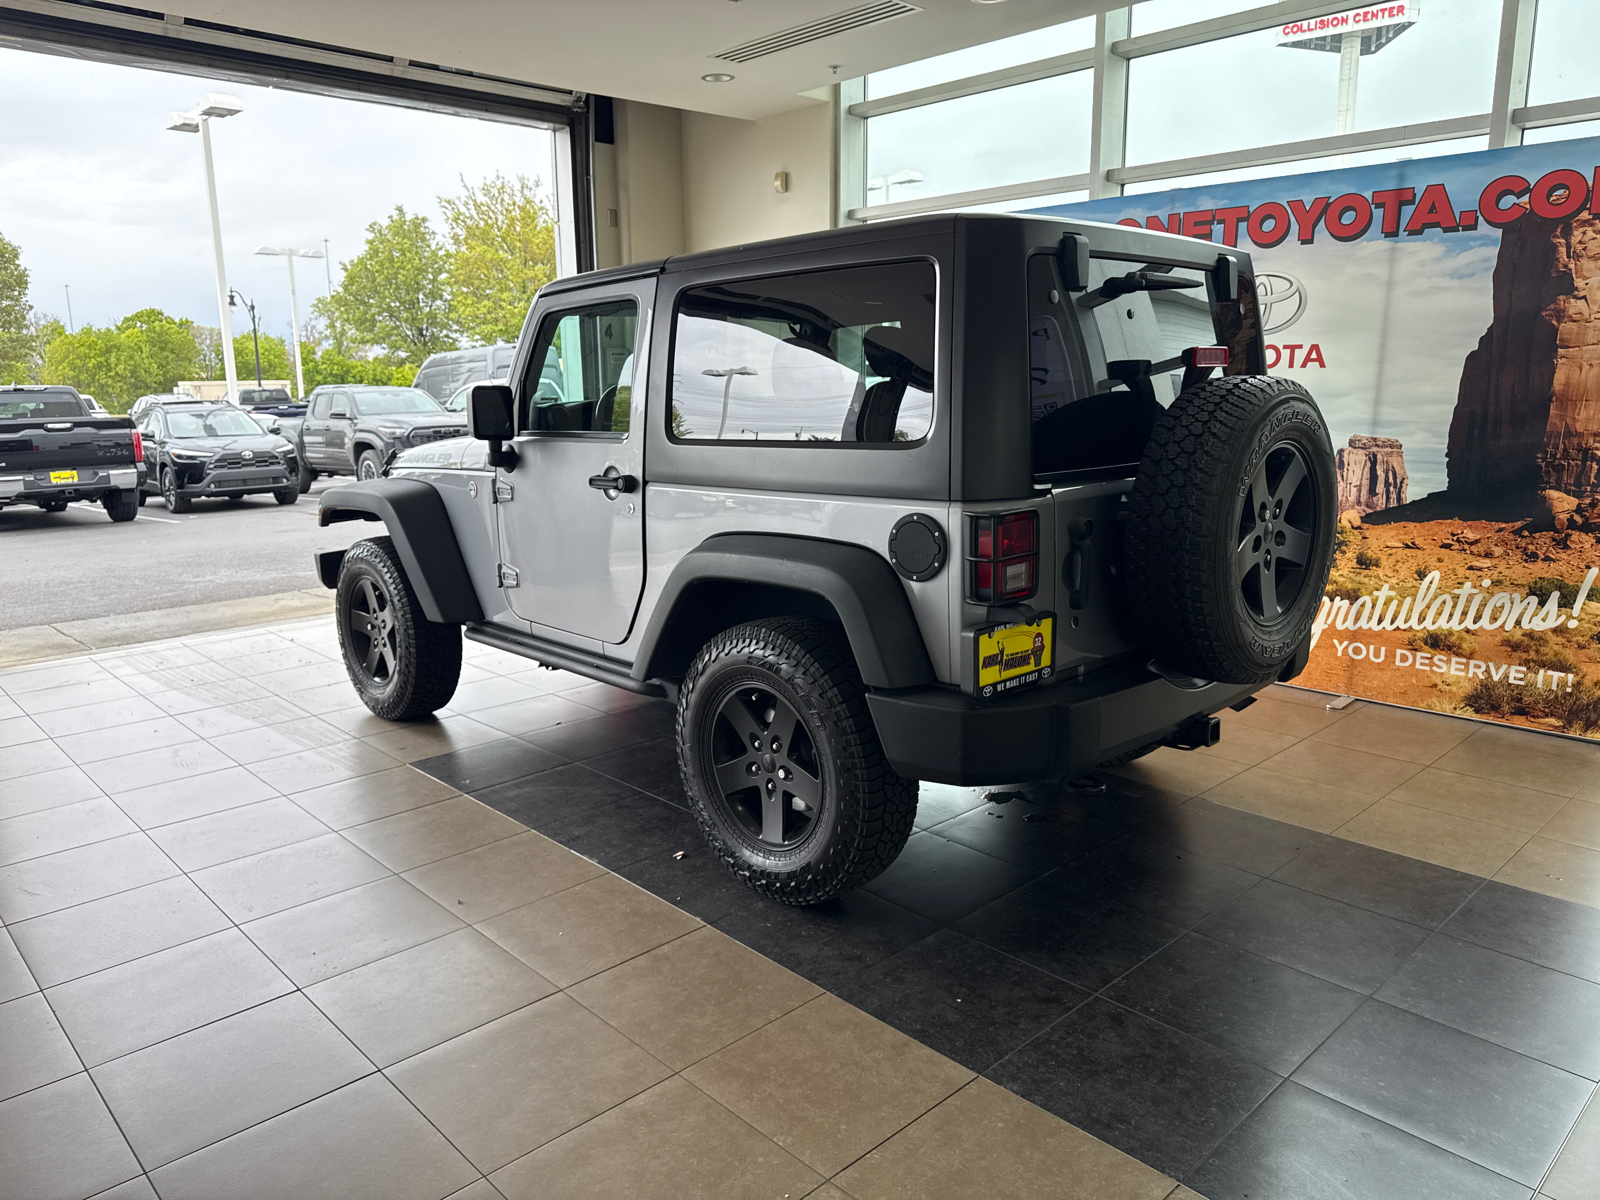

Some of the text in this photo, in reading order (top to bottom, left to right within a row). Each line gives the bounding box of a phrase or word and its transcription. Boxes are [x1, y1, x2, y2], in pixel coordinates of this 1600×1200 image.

[1282, 4, 1405, 36] COLLISION CENTER
[1238, 409, 1322, 497] WRANGLER
[912, 547, 932, 559] Jeep
[1034, 637, 1042, 647] 32
[1003, 653, 1032, 672] MALONE
[1332, 638, 1575, 693] YOU DESERVE IT!
[996, 672, 1039, 692] WE MAKE IT EASY
